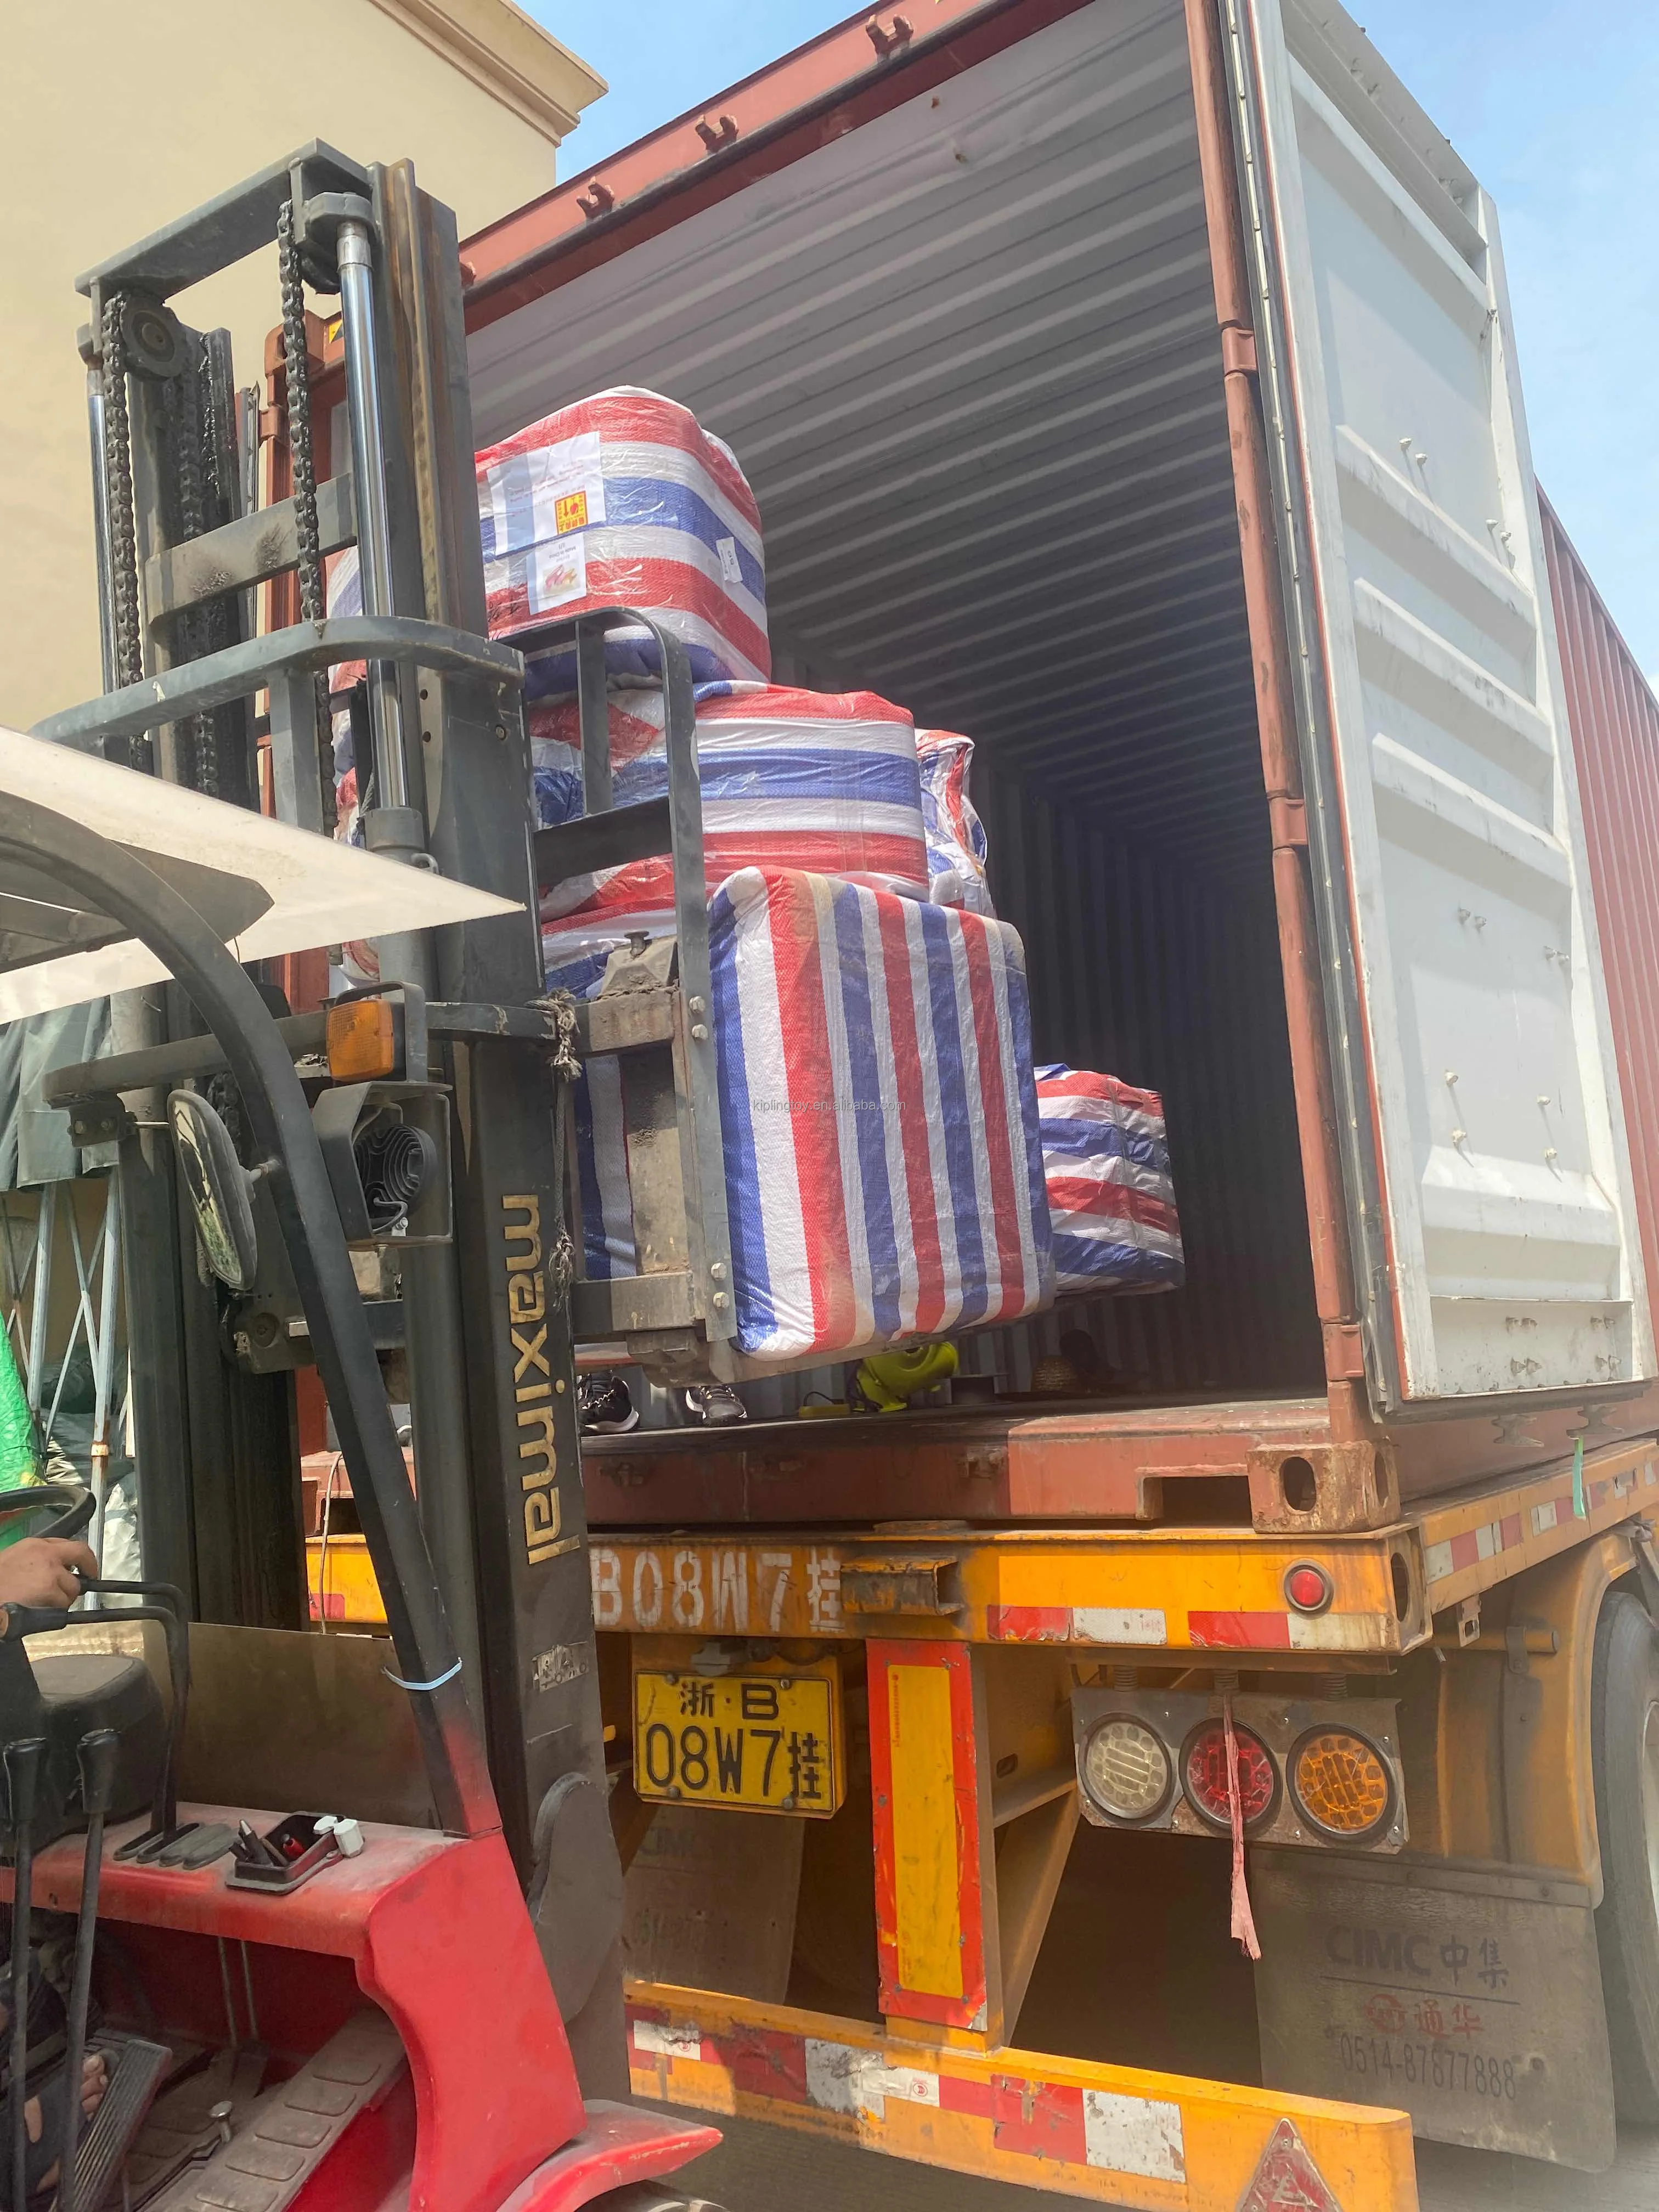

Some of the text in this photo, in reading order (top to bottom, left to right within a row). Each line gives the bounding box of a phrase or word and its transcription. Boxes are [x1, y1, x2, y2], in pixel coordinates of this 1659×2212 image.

[502, 1194, 580, 1565] maximal
[646, 1723, 822, 1799] 08W7挂
[1324, 1924, 1510, 1989] CIMC 中集
